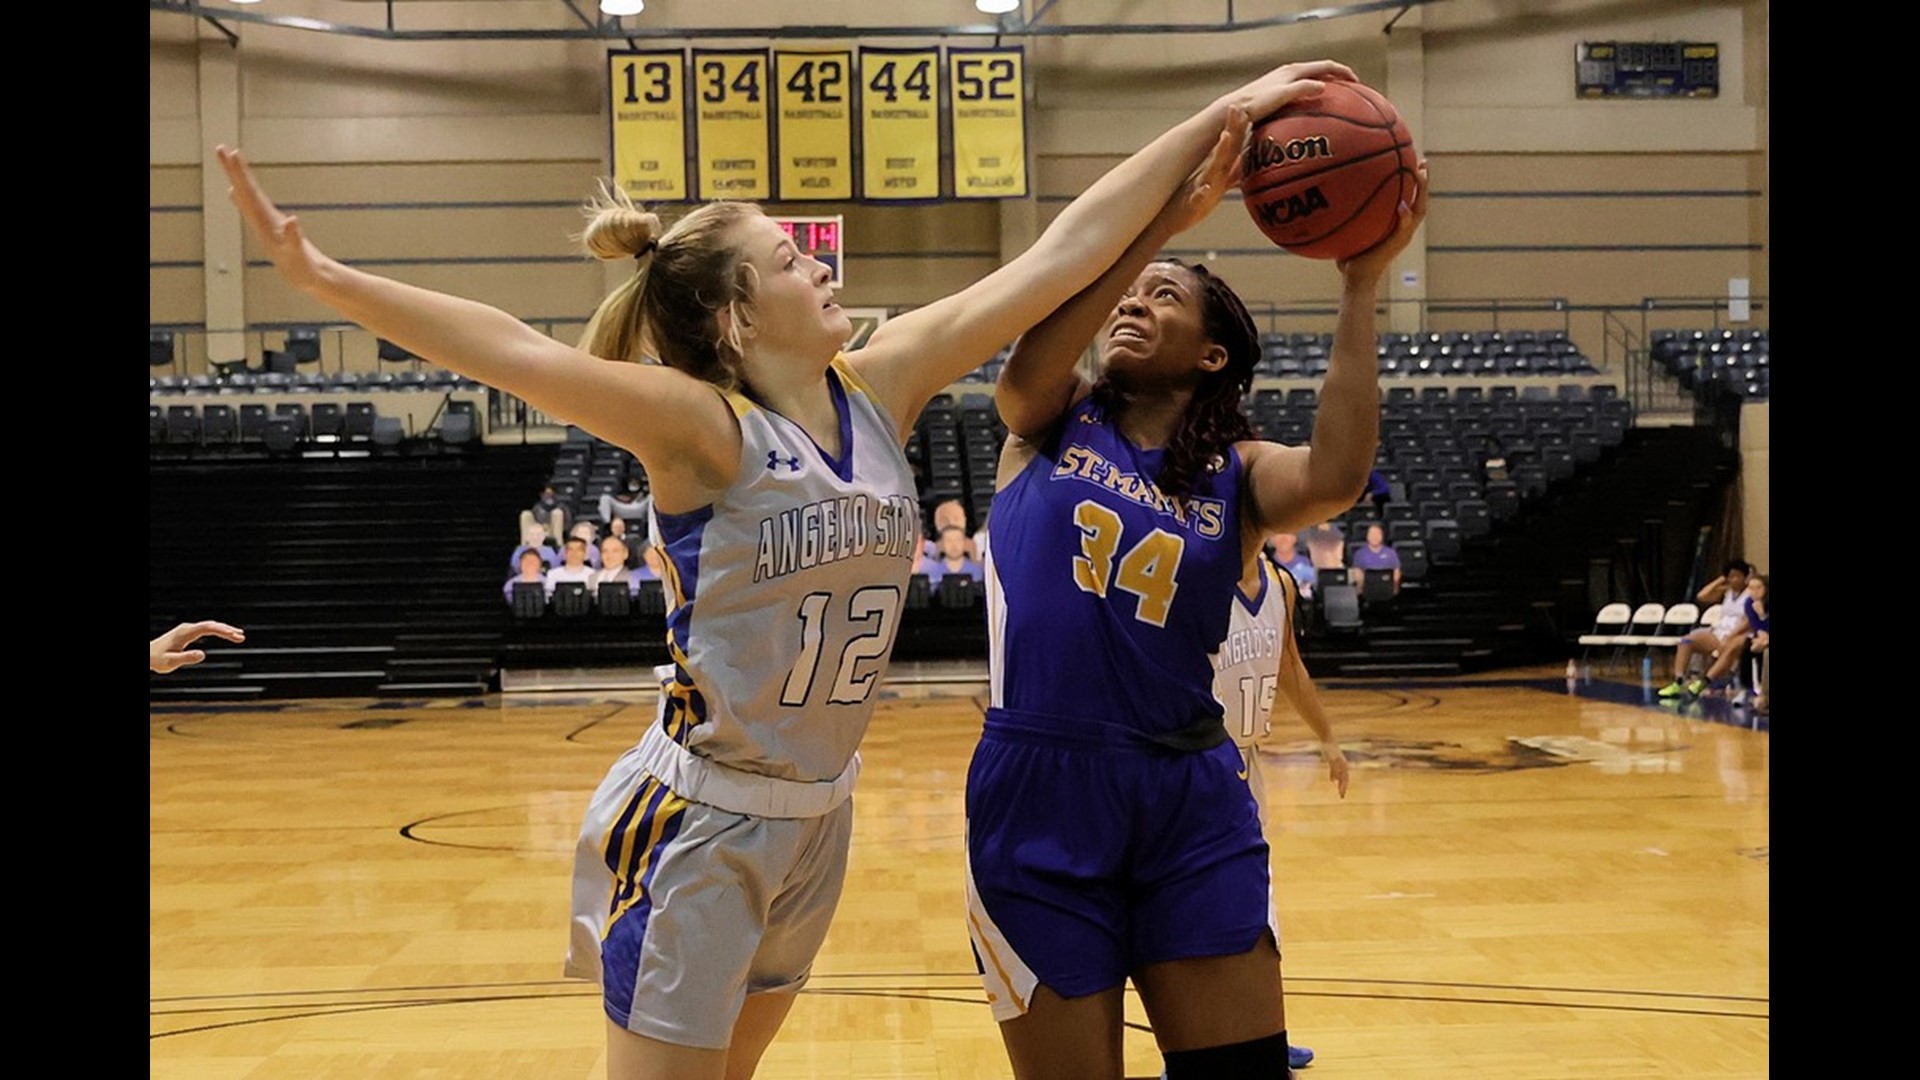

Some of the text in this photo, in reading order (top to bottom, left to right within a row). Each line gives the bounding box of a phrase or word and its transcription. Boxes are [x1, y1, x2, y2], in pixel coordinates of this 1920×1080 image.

[623, 61, 672, 104] 13
[703, 61, 761, 104] 34
[787, 61, 842, 103] 42
[870, 60, 932, 102] 44
[957, 60, 1016, 101] 52
[1254, 186, 1330, 226] NCAA
[753, 494, 920, 583] ANGELO STA
[1072, 499, 1186, 629] 34
[779, 585, 901, 707] 12
[1240, 673, 1278, 738] 15
